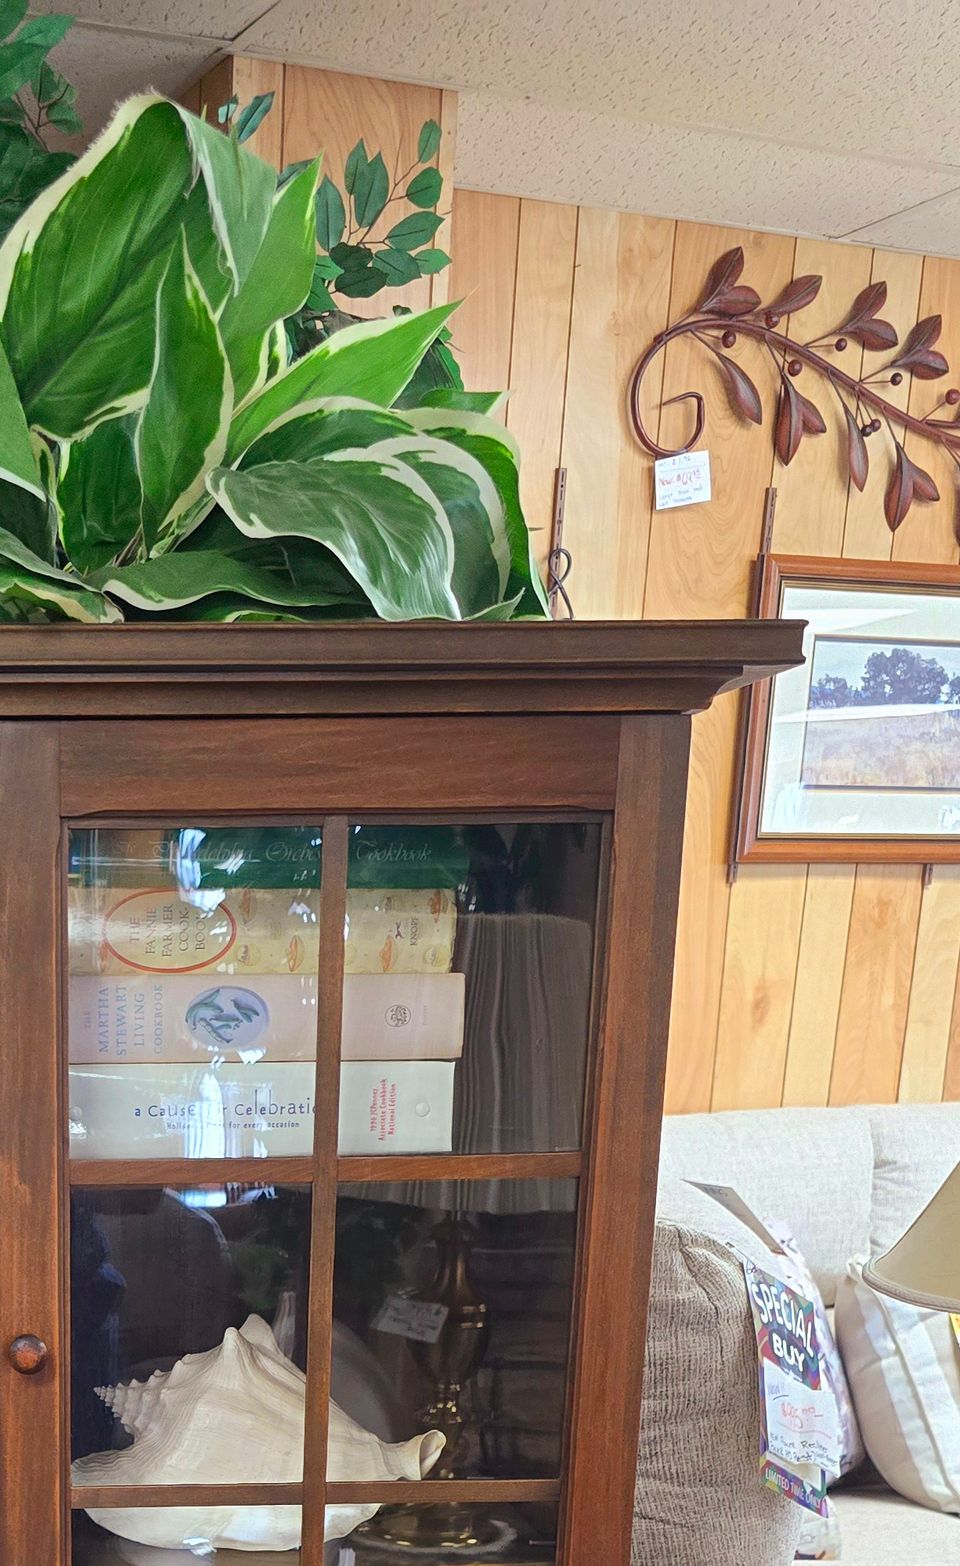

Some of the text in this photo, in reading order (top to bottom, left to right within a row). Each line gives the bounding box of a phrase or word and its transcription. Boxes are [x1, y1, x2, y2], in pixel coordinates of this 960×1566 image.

[129, 917, 139, 944] THE
[144, 908, 156, 955] FANNIE
[162, 903, 174, 958] FARMER
[409, 915, 418, 946] KNOPF
[98, 986, 108, 1054] MARTHA
[116, 984, 127, 1057] STEWART
[134, 992, 145, 1047] LIVING
[153, 984, 163, 1055] COOKBOOK
[134, 1107, 141, 1117] a
[148, 1104, 198, 1118] Cause
[234, 1088, 315, 1117] Celebrati
[378, 1078, 388, 1110] Cookbook
[387, 1083, 397, 1136] National Edition
[750, 1283, 815, 1359] SPECIAL
[771, 1336, 806, 1373] BUY
[765, 1467, 790, 1492] LIMITED
